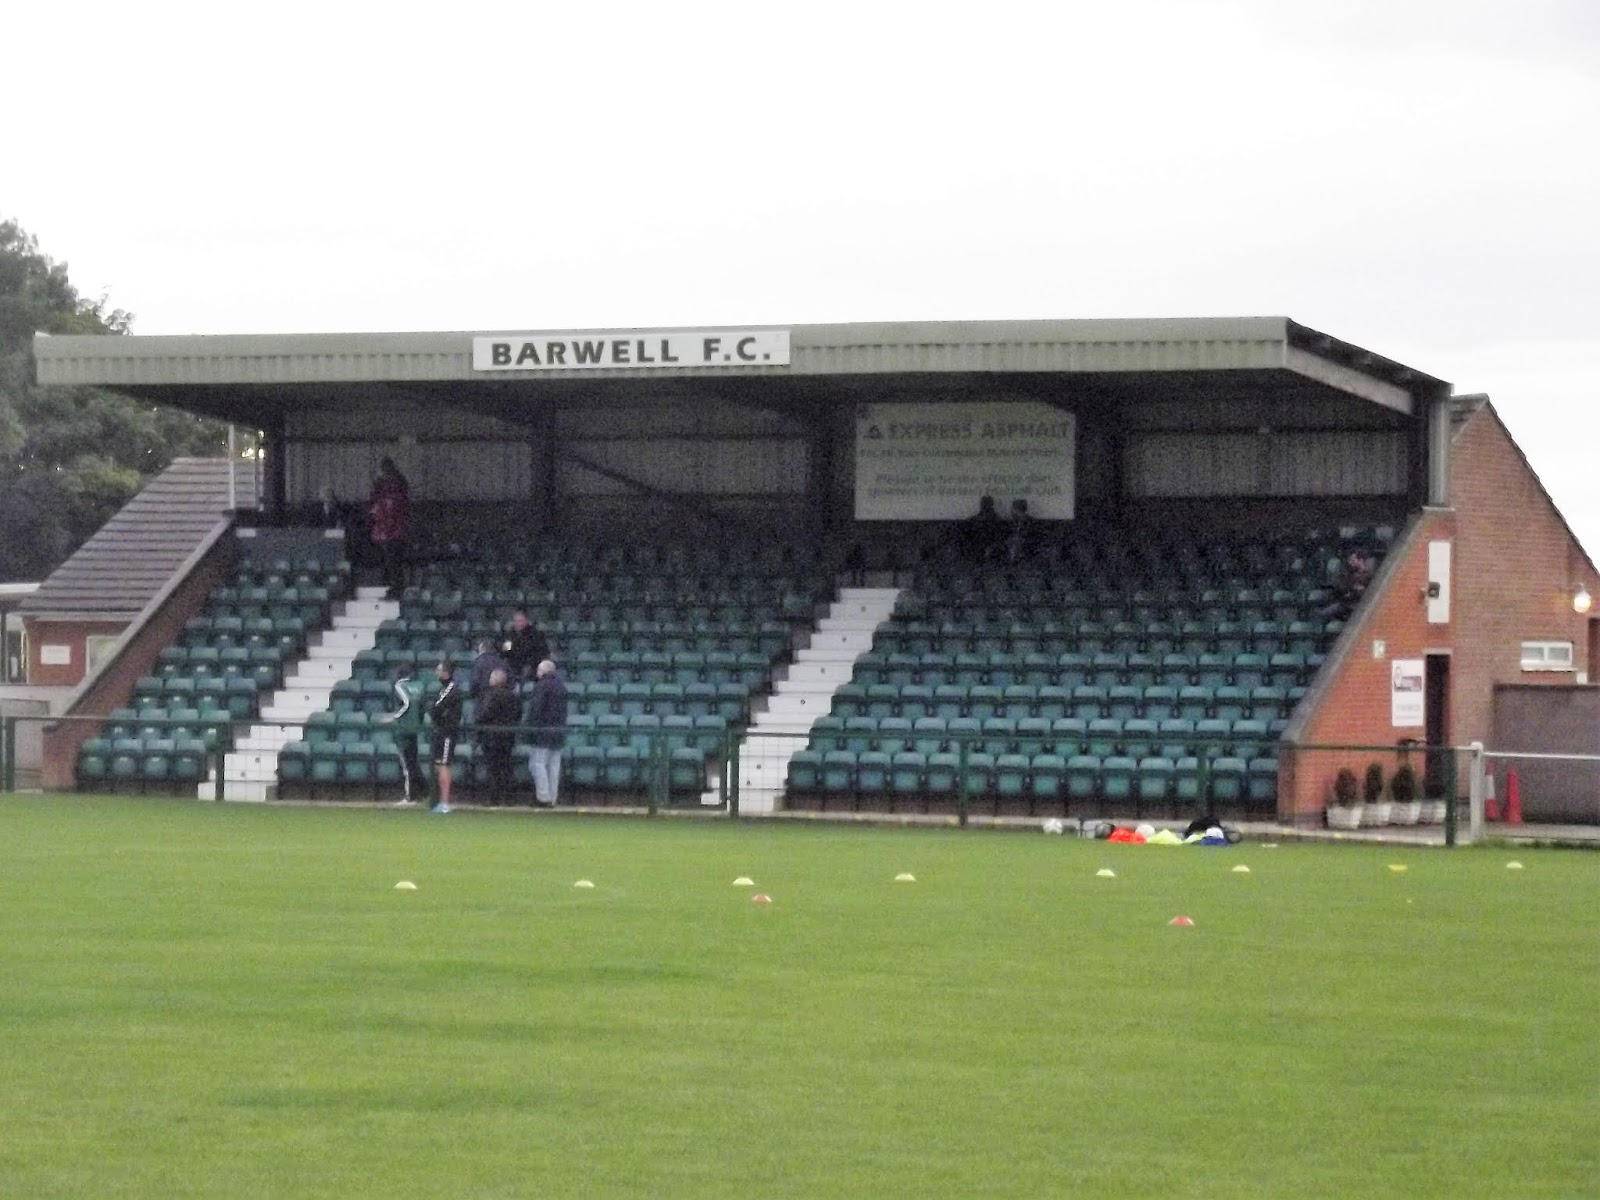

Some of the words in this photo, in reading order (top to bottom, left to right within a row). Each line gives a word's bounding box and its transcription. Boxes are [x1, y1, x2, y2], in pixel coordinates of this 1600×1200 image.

[492, 339, 679, 366] BARWELL
[703, 337, 771, 361] F.C.
[888, 423, 971, 439] EXPRESS
[981, 421, 1069, 438] ASPHALT
